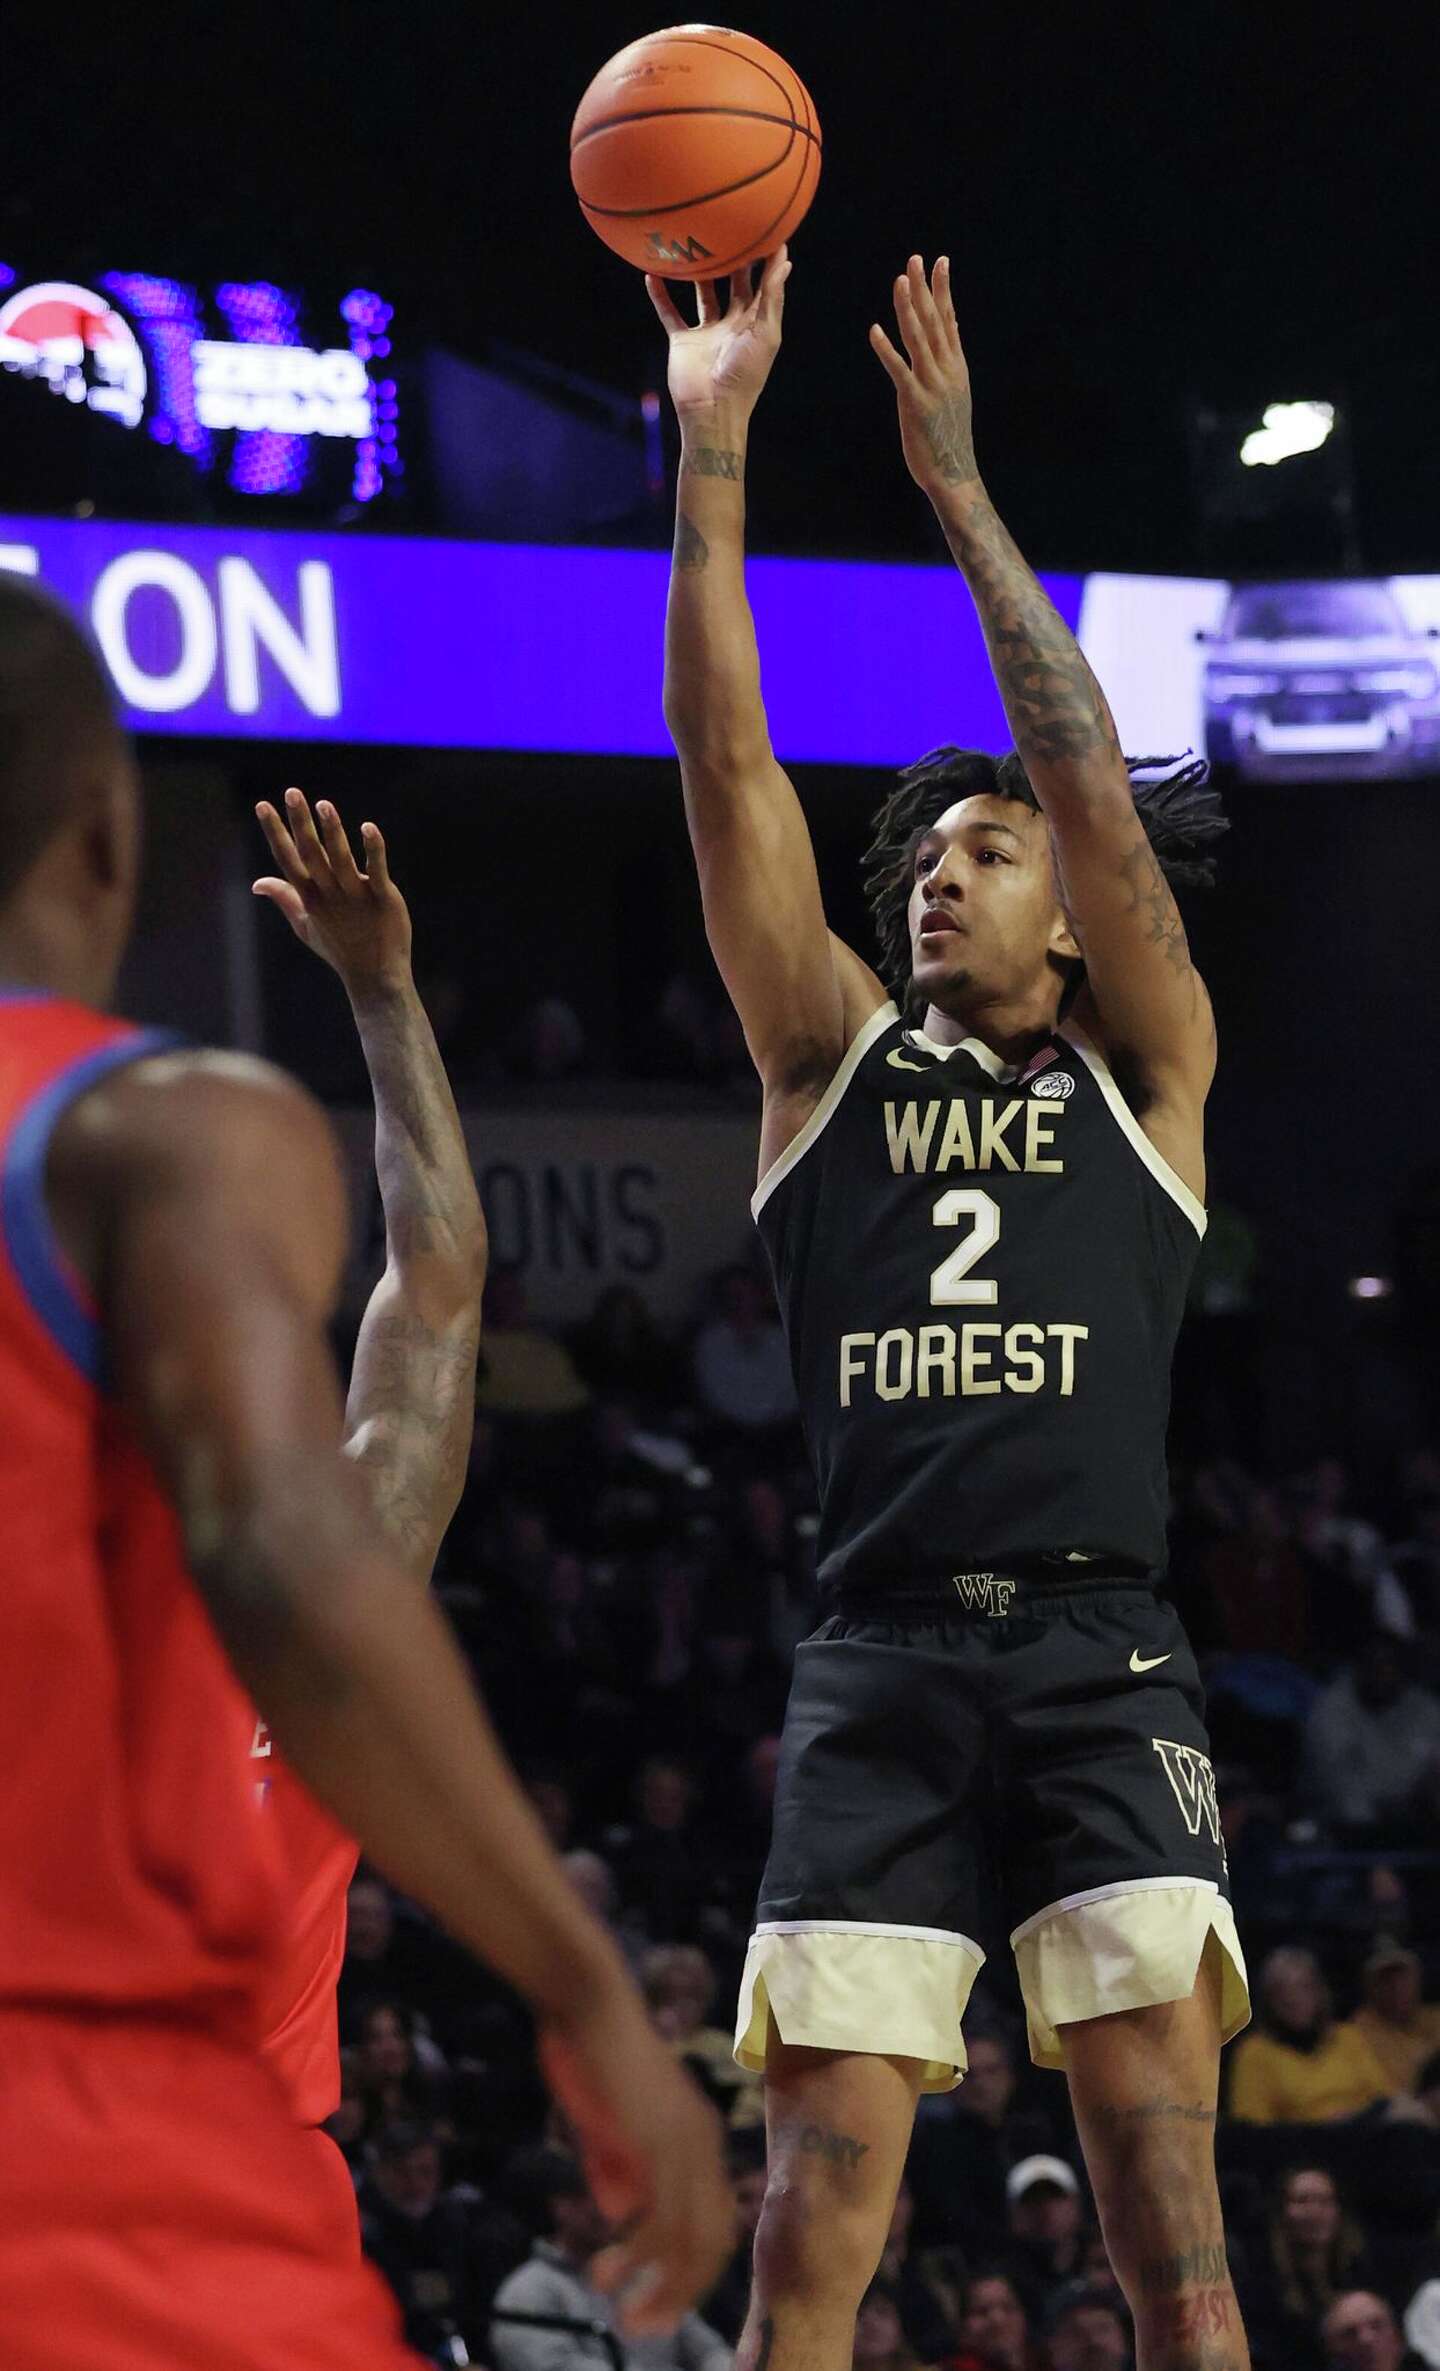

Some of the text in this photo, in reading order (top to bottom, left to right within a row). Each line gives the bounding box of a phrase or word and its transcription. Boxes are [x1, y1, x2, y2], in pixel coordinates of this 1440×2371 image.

[91, 550, 341, 717] ON
[884, 1099, 1065, 1174] WAKE
[930, 1188, 1001, 1306] 2
[839, 1323, 1089, 1408] FOREST
